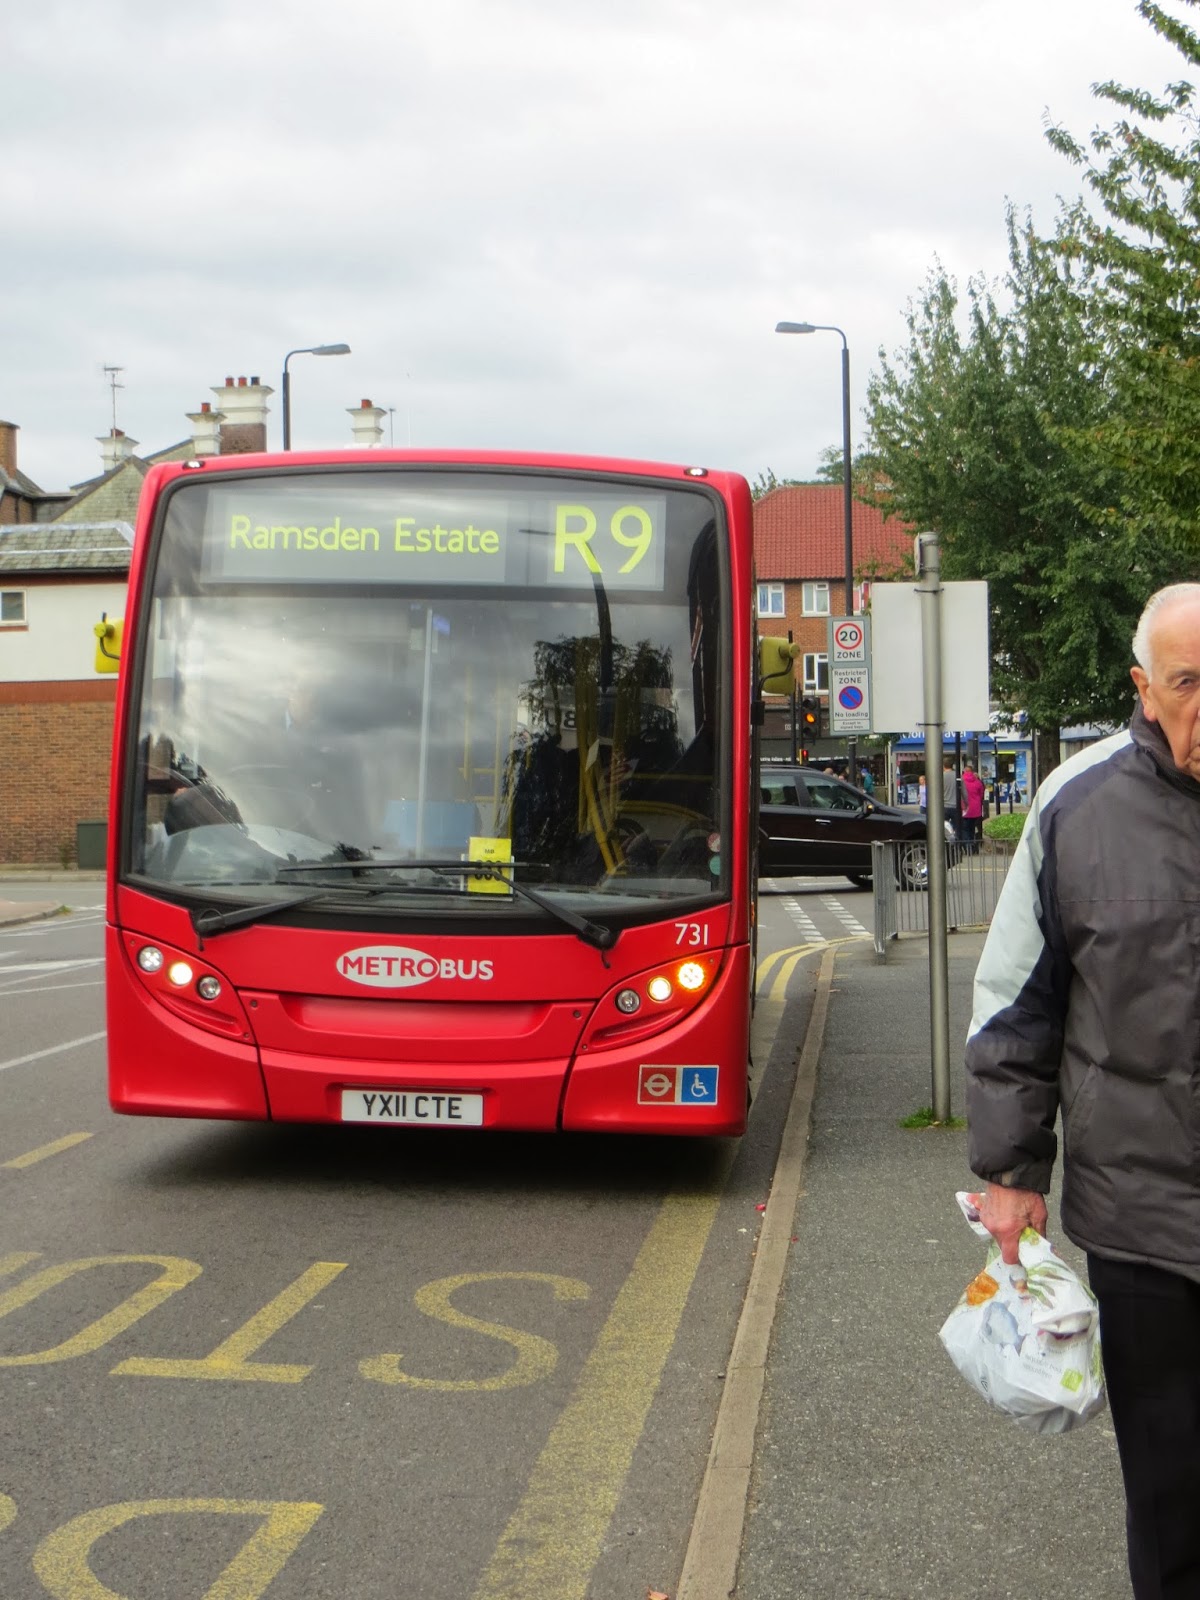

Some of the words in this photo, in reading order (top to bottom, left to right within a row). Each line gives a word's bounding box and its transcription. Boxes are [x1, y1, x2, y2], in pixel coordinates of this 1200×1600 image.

[230, 515, 380, 551] Ramsden
[394, 518, 499, 554] Estate
[840, 630, 859, 642] 20
[836, 651, 862, 659] ZONE
[675, 923, 709, 945] 731
[342, 955, 494, 981] METROBUS
[362, 1093, 407, 1117] YX11
[414, 1095, 463, 1119] CTE
